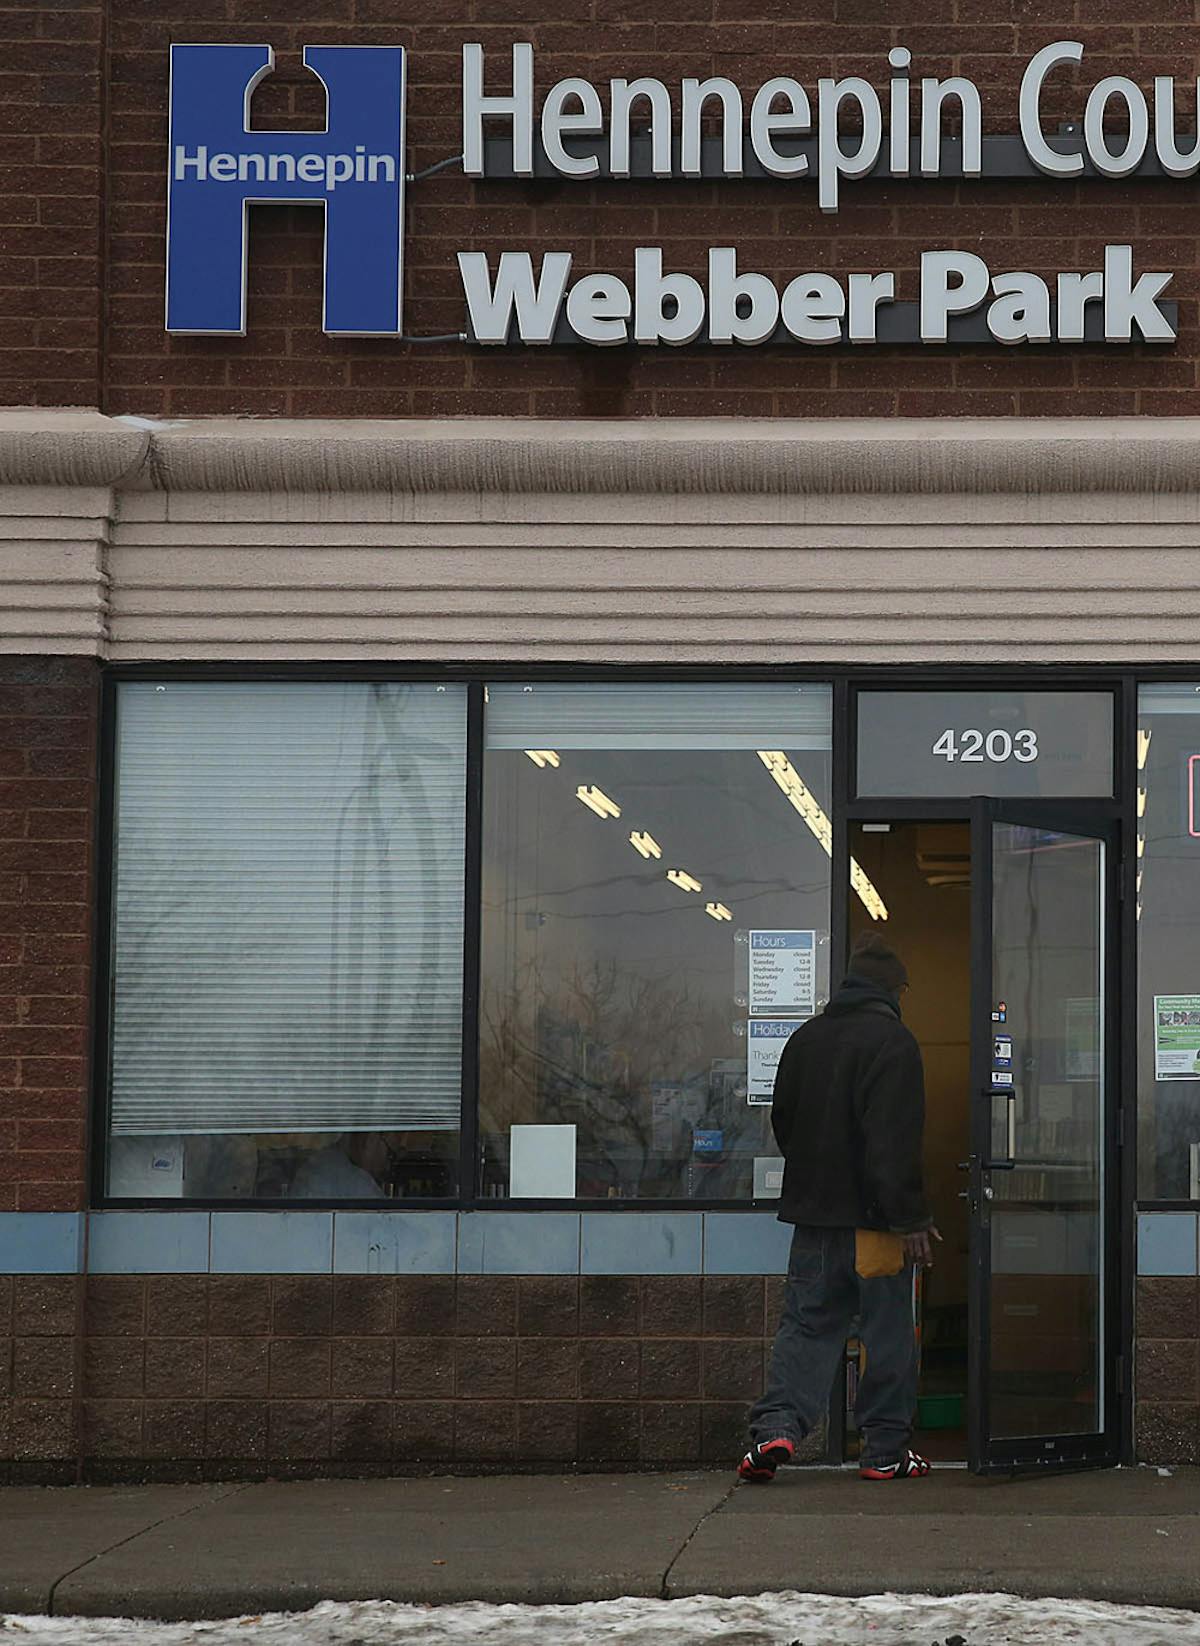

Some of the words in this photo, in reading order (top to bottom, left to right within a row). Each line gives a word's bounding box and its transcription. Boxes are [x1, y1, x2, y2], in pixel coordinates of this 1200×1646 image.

[463, 43, 983, 213] Hennepin
[174, 145, 395, 192] Hennepin
[458, 247, 895, 345] Webber
[920, 244, 1177, 345] Park
[932, 728, 1039, 763] 4203
[753, 935, 786, 948] Hours
